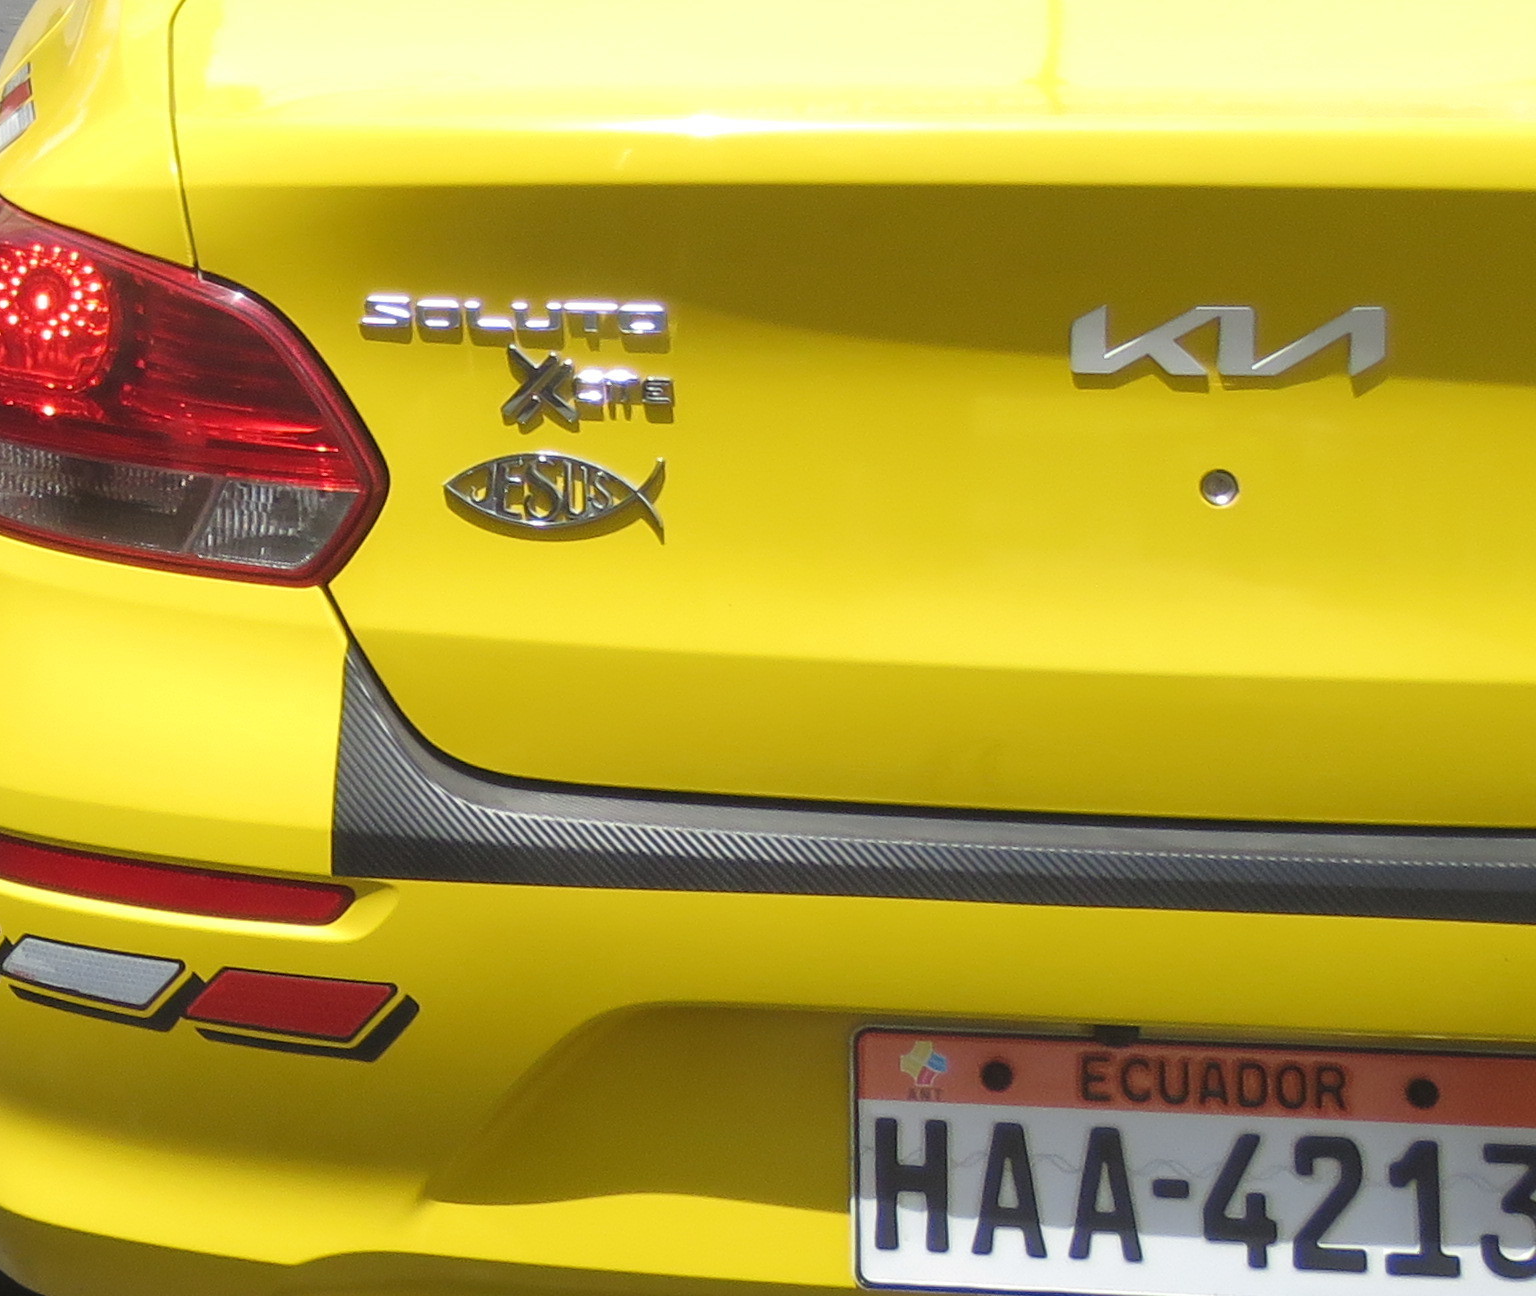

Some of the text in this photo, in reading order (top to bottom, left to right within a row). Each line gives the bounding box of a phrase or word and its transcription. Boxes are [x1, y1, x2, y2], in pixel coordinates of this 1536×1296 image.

[360, 294, 669, 334] SOLUTO
[469, 458, 615, 522] JESUS
[1078, 1051, 1348, 1112] ECUADOR
[873, 1116, 1536, 1280] HAA-4213
